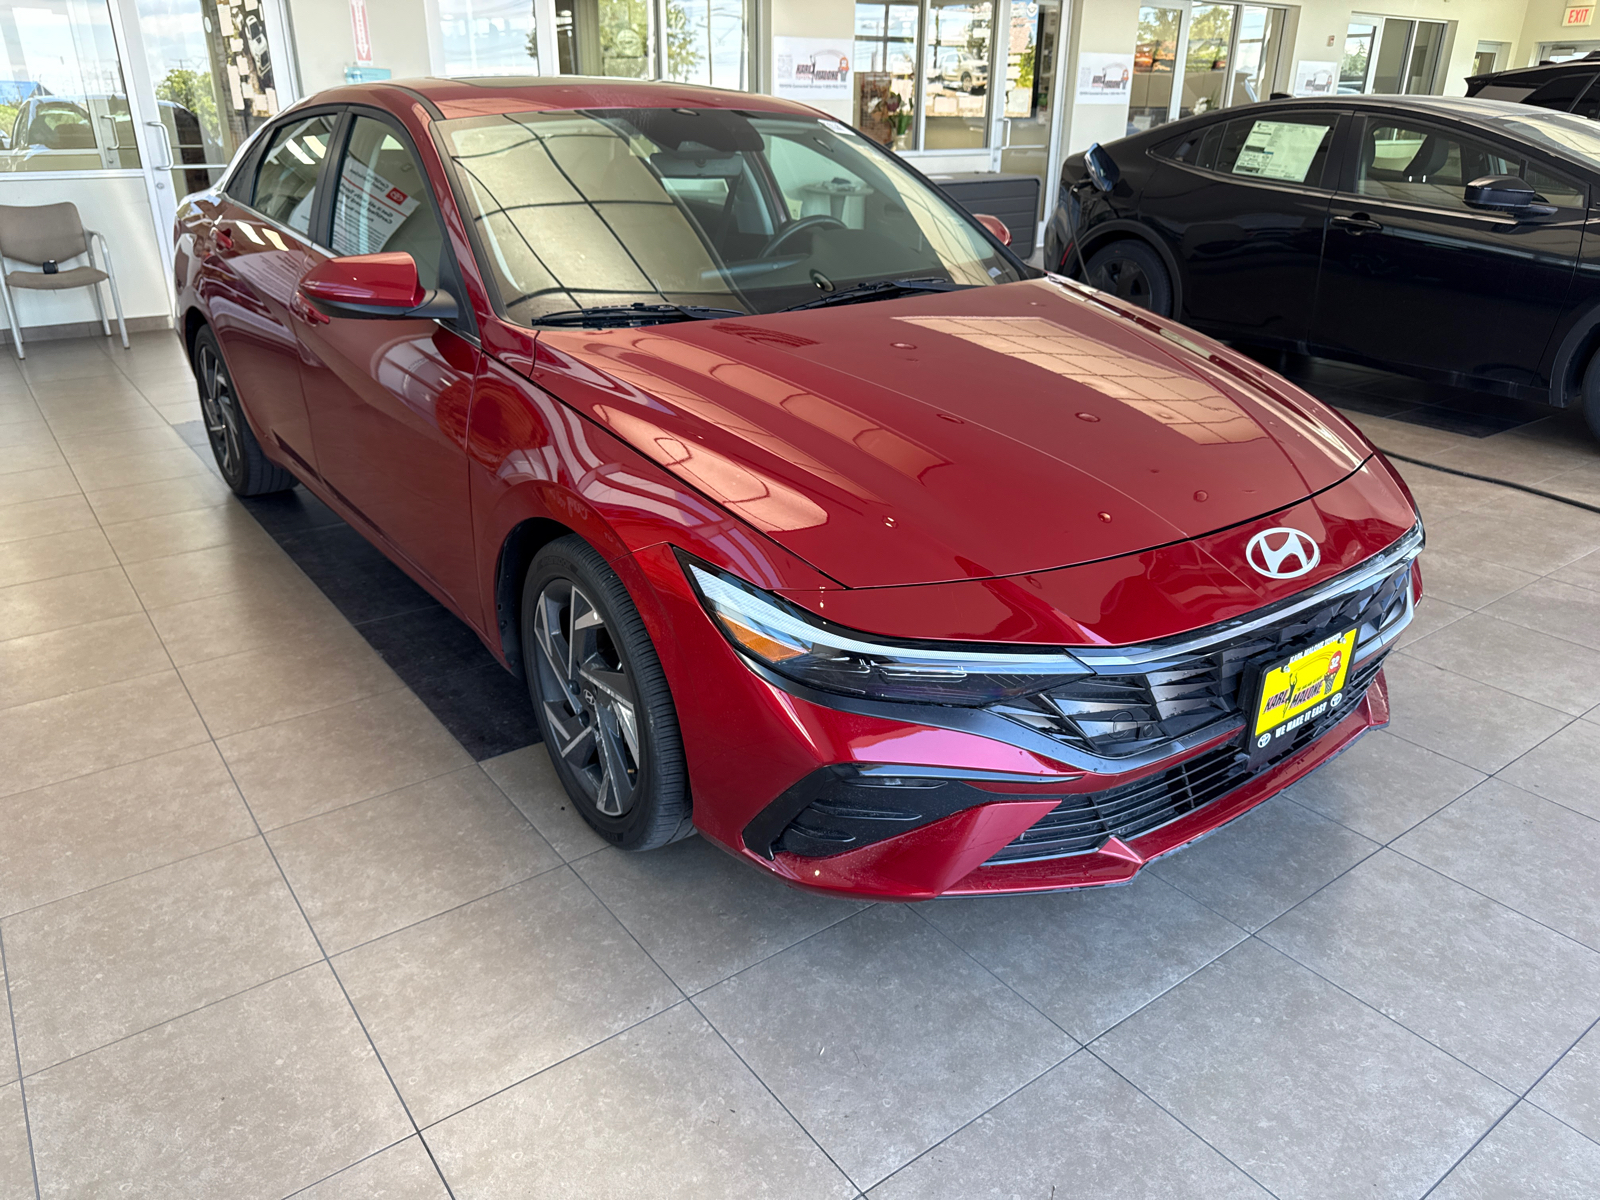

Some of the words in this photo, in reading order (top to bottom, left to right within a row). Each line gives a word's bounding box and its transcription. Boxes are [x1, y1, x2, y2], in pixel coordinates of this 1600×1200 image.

[1568, 9, 1589, 23] EXIT
[1330, 655, 1340, 669] 32
[1262, 688, 1289, 715] KARL
[1289, 680, 1323, 709] MALONE
[1275, 725, 1286, 738] WE
[1286, 715, 1304, 732] MAKE
[1304, 710, 1311, 722] IT
[1311, 702, 1328, 718] EASY
